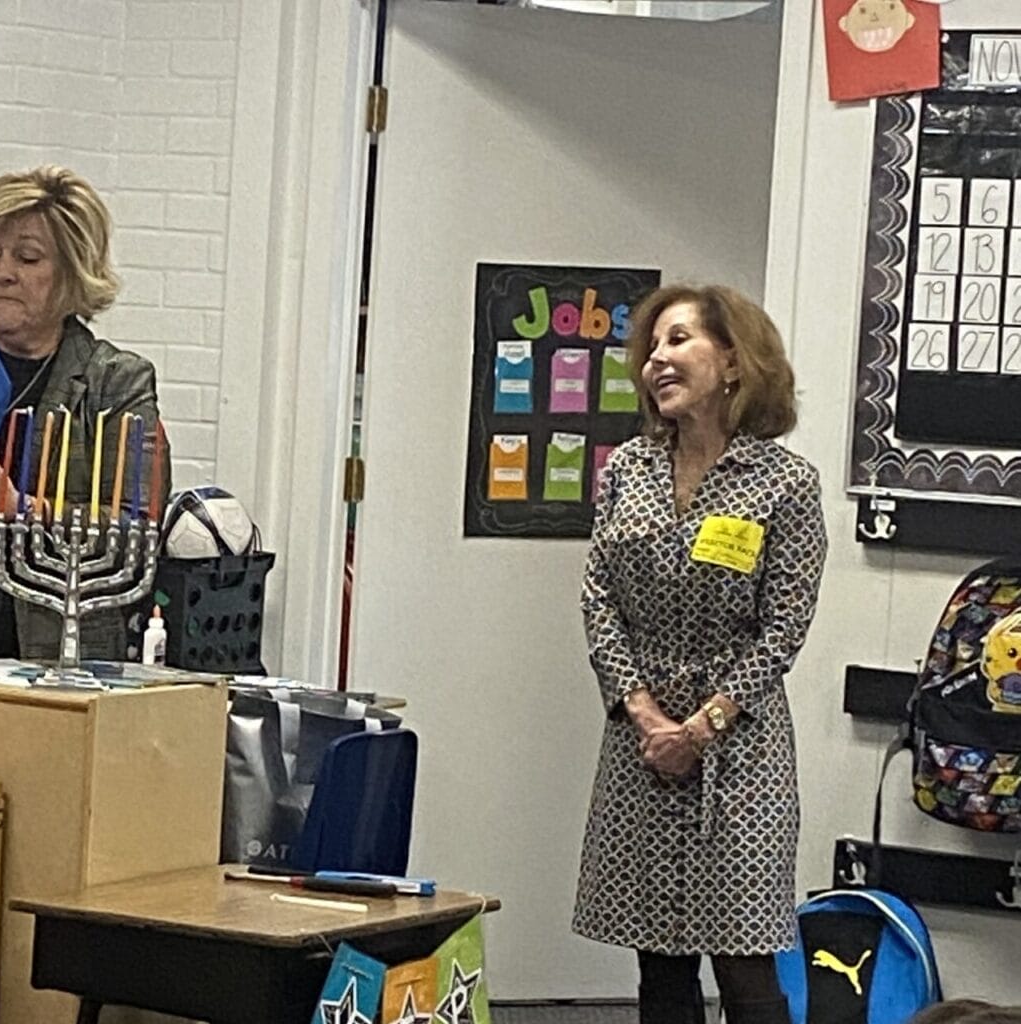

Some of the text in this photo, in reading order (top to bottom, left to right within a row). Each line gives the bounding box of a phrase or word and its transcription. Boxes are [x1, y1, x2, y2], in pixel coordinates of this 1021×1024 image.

[932, 183, 998, 224] 5 6
[926, 232, 996, 273] 12 13
[512, 286, 632, 340] Jobs
[923, 281, 947, 319] 19
[963, 281, 997, 321] 20
[911, 329, 945, 368] 26
[961, 330, 995, 370] 27
